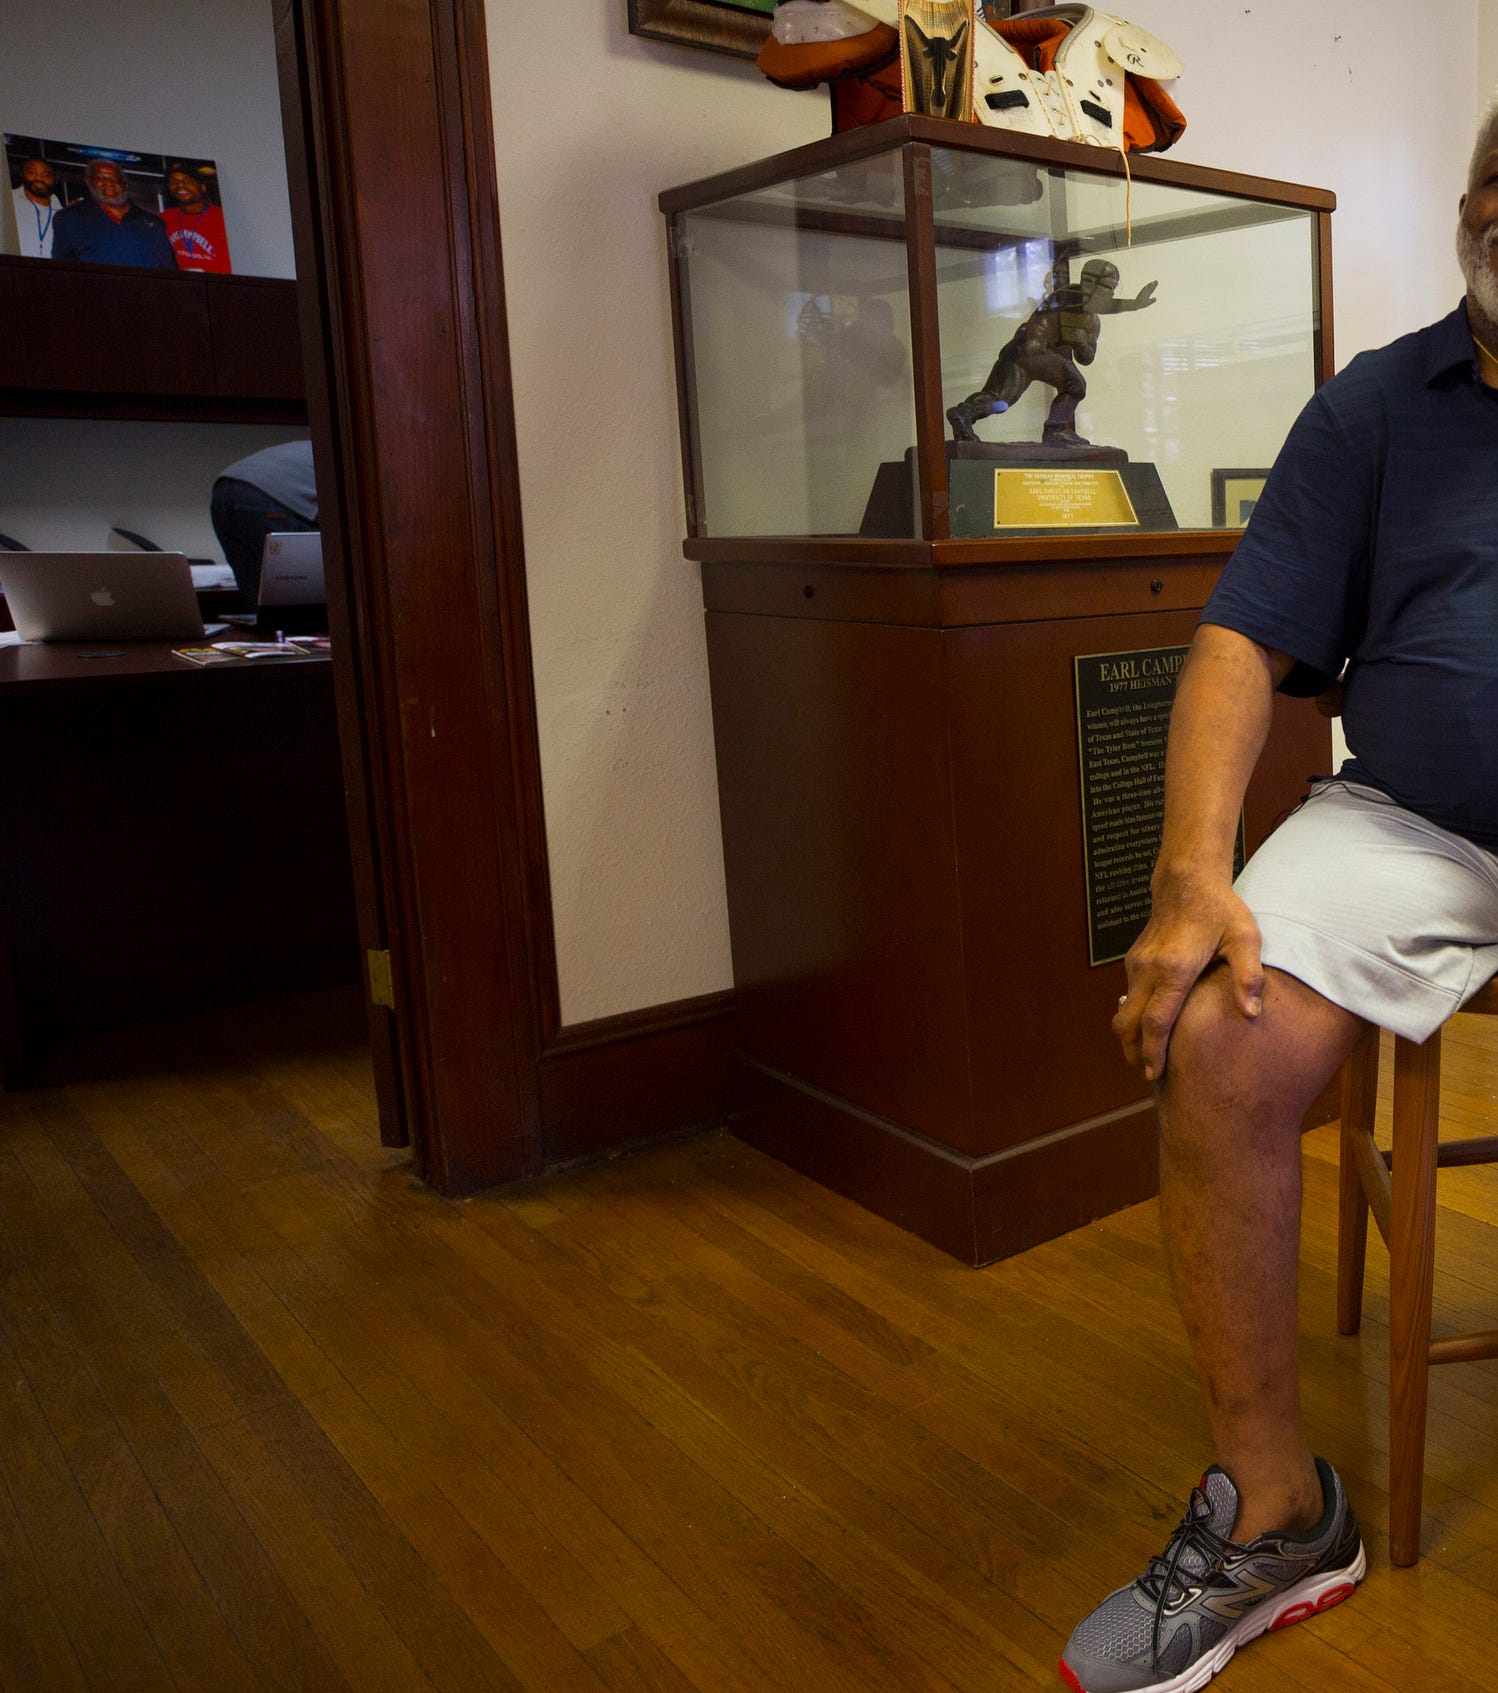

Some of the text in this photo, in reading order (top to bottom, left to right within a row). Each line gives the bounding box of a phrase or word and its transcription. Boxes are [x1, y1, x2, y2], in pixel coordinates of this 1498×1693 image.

[1100, 655, 1186, 682] EARL CAMP
[1110, 675, 1173, 692] 1977 HEISMAN
[1086, 708, 1101, 718] Earl
[1112, 731, 1124, 739] and
[1124, 729, 1139, 737] State
[1089, 759, 1103, 768] East
[1121, 751, 1149, 763] Campbell
[1090, 771, 1110, 781] college
[1110, 768, 1122, 777] and
[1112, 780, 1134, 790] College
[1092, 807, 1121, 818] American
[1092, 834, 1105, 844] and
[1107, 829, 1128, 841] respect
[1094, 871, 1109, 881] NFL
[1096, 893, 1121, 905] returned
